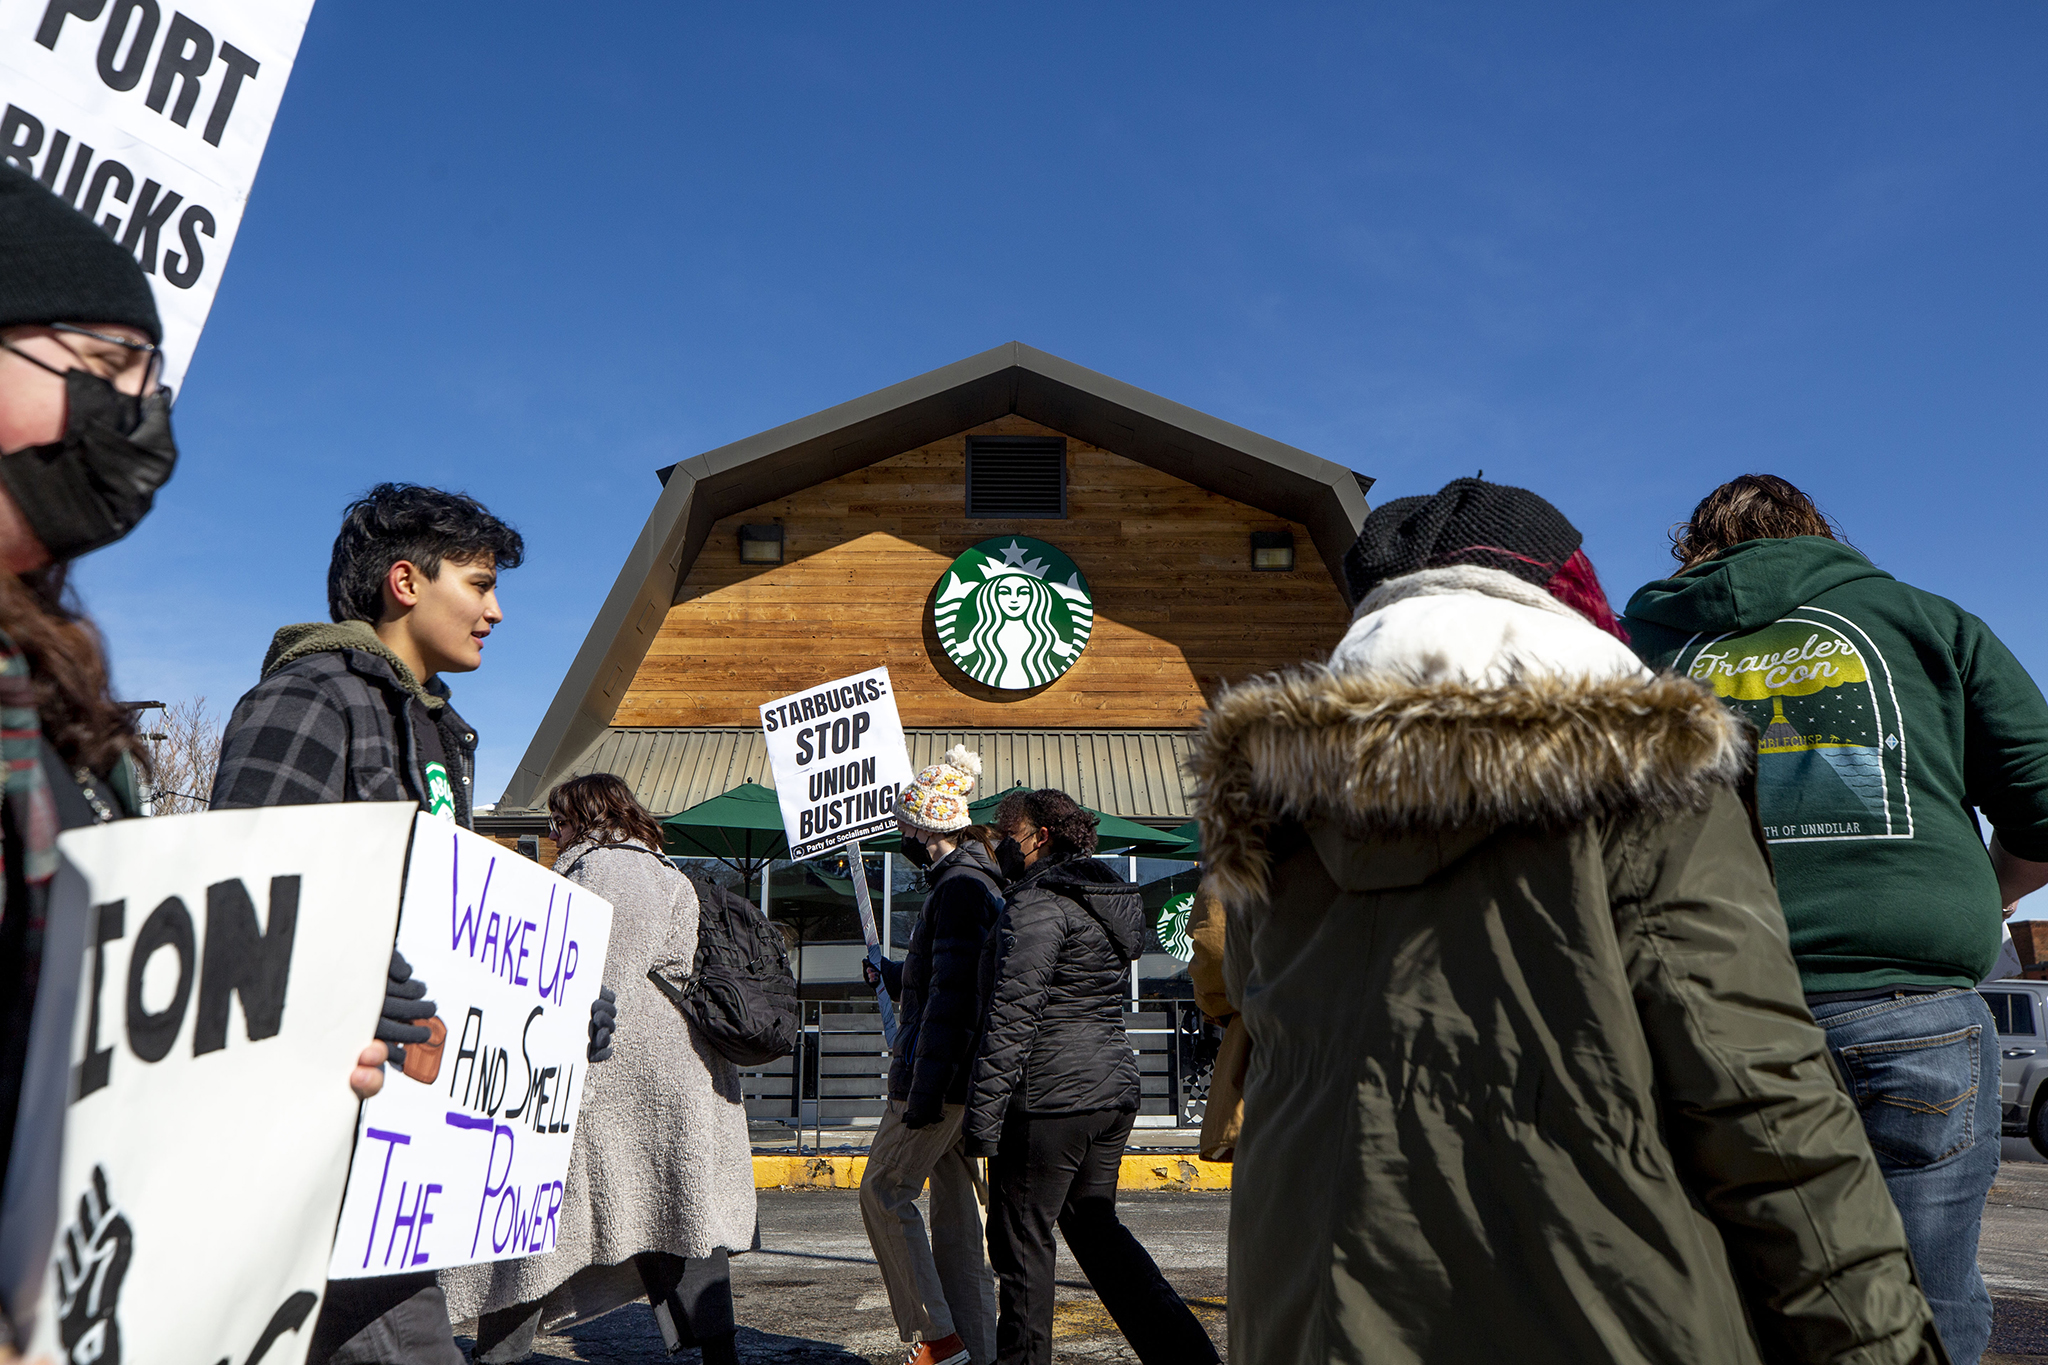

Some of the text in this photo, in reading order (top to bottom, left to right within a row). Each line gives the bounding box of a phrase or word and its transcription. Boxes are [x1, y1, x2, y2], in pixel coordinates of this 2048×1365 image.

[1693, 633, 1856, 681] Traveler
[764, 678, 887, 732] STARBUCKS:
[796, 711, 871, 766] STOP
[809, 756, 876, 802] UNION
[806, 841, 825, 853] Party
[825, 837, 836, 847] for
[836, 828, 870, 842] Socialism
[870, 821, 884, 833] and
[1782, 825, 1797, 836] OF
[1800, 822, 1861, 835] UNNDILAR
[452, 833, 578, 1007] WAKE UP
[450, 1005, 574, 1134] AND SMELL
[362, 1124, 563, 1269] THE POWER
